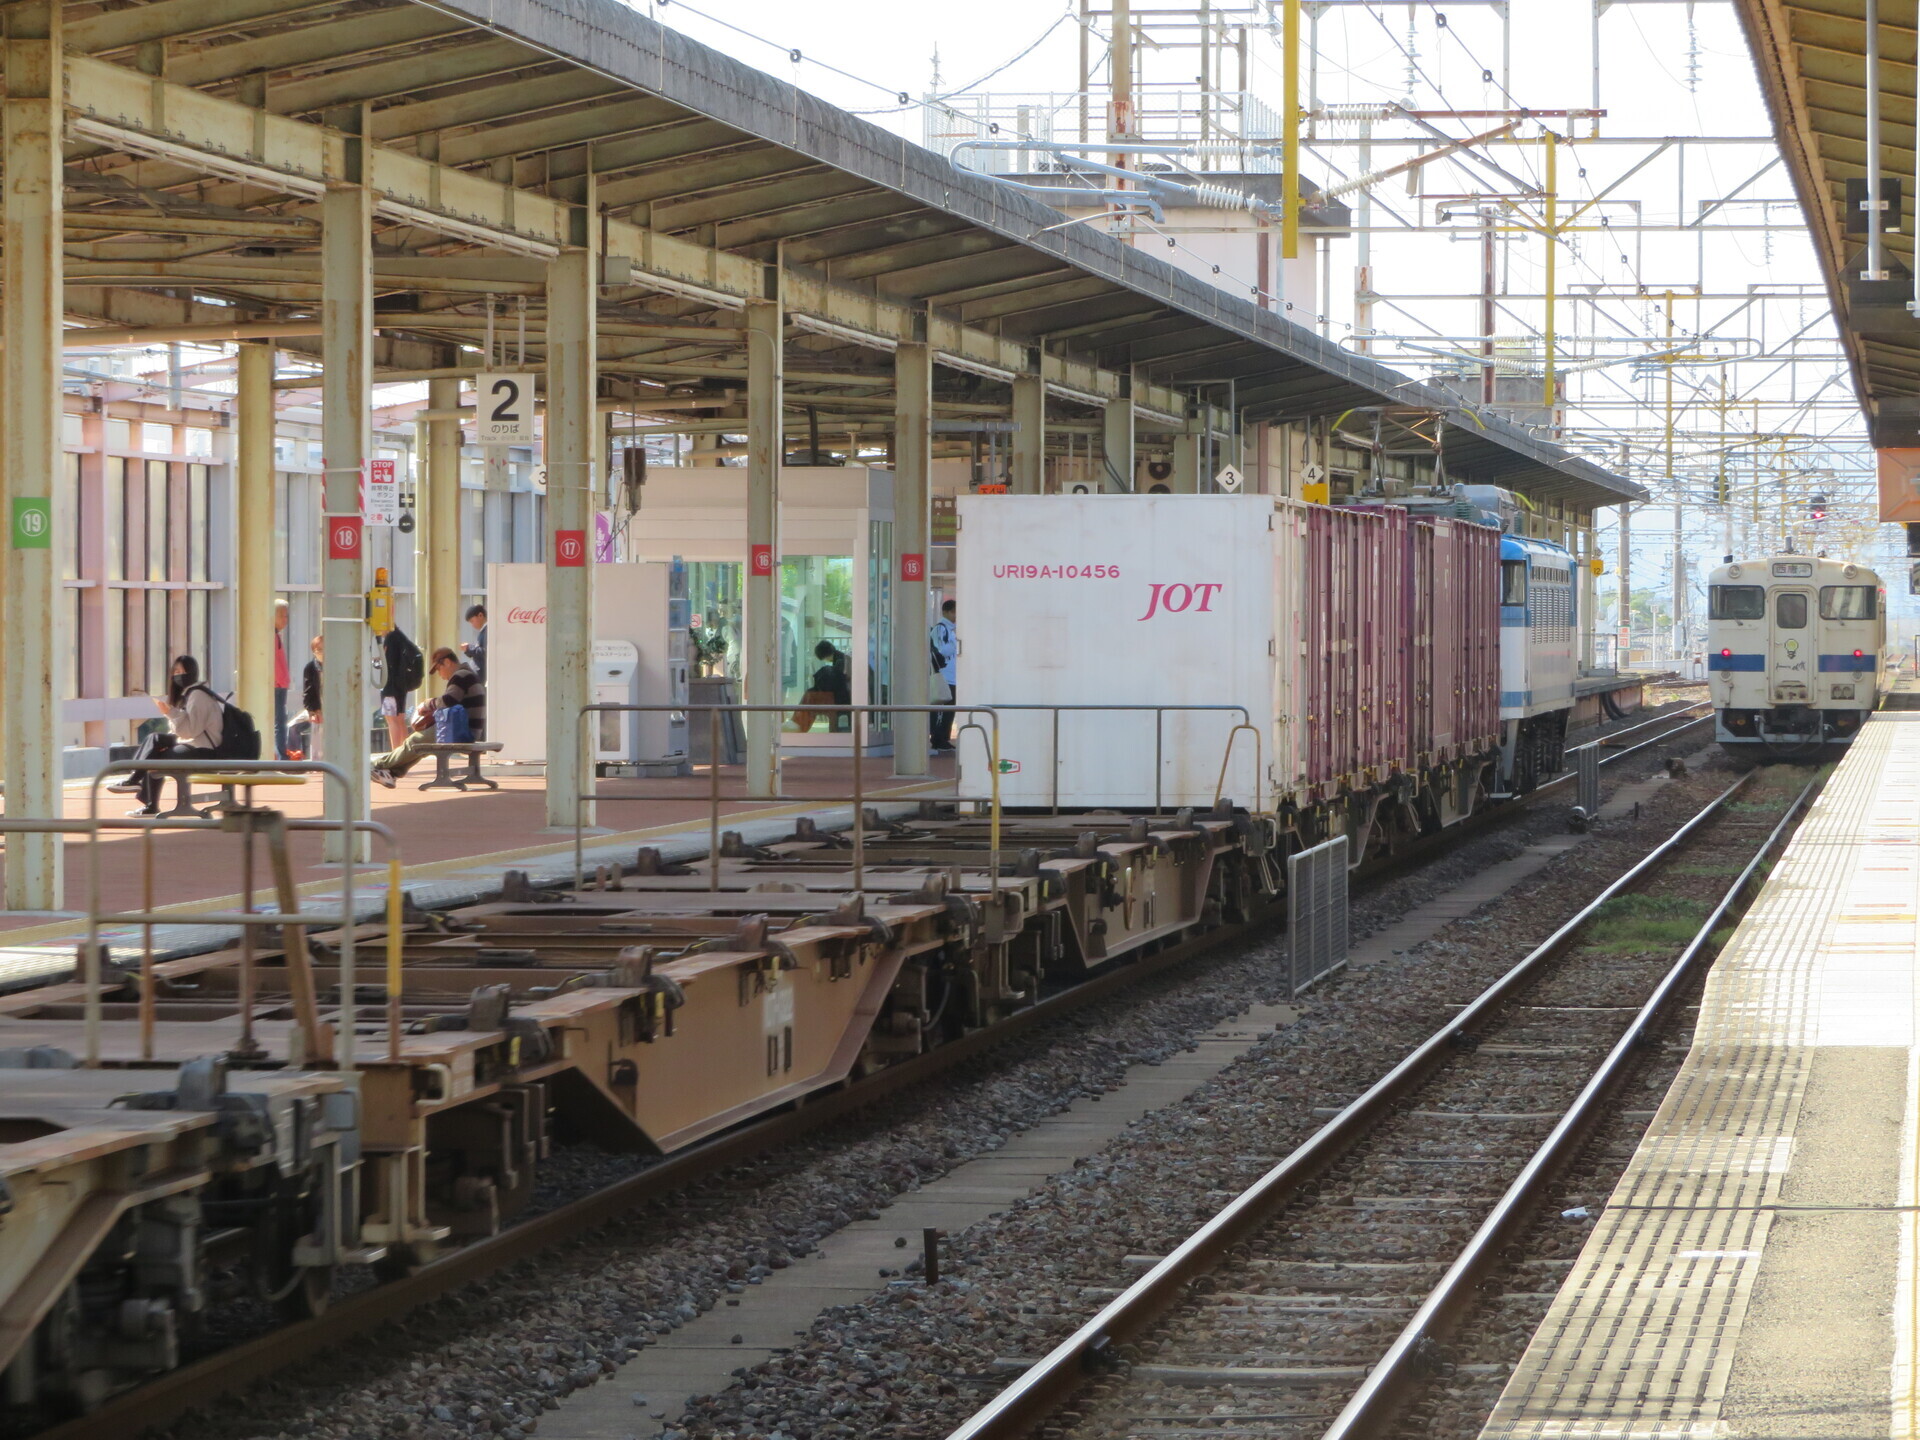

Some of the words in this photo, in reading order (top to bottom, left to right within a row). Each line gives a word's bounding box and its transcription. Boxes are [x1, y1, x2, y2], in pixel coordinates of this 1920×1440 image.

[491, 379, 519, 421] 2
[491, 424, 520, 434] のりば
[538, 471, 546, 485] 3
[1225, 471, 1235, 485] 3
[1307, 467, 1316, 480] 4
[24, 513, 42, 532] 19
[339, 530, 353, 546] 18
[564, 542, 576, 555] 17
[759, 554, 770, 567] 16
[907, 562, 917, 573] 15
[1137, 583, 1223, 621] JOT
[507, 606, 547, 624] Coca-Co
